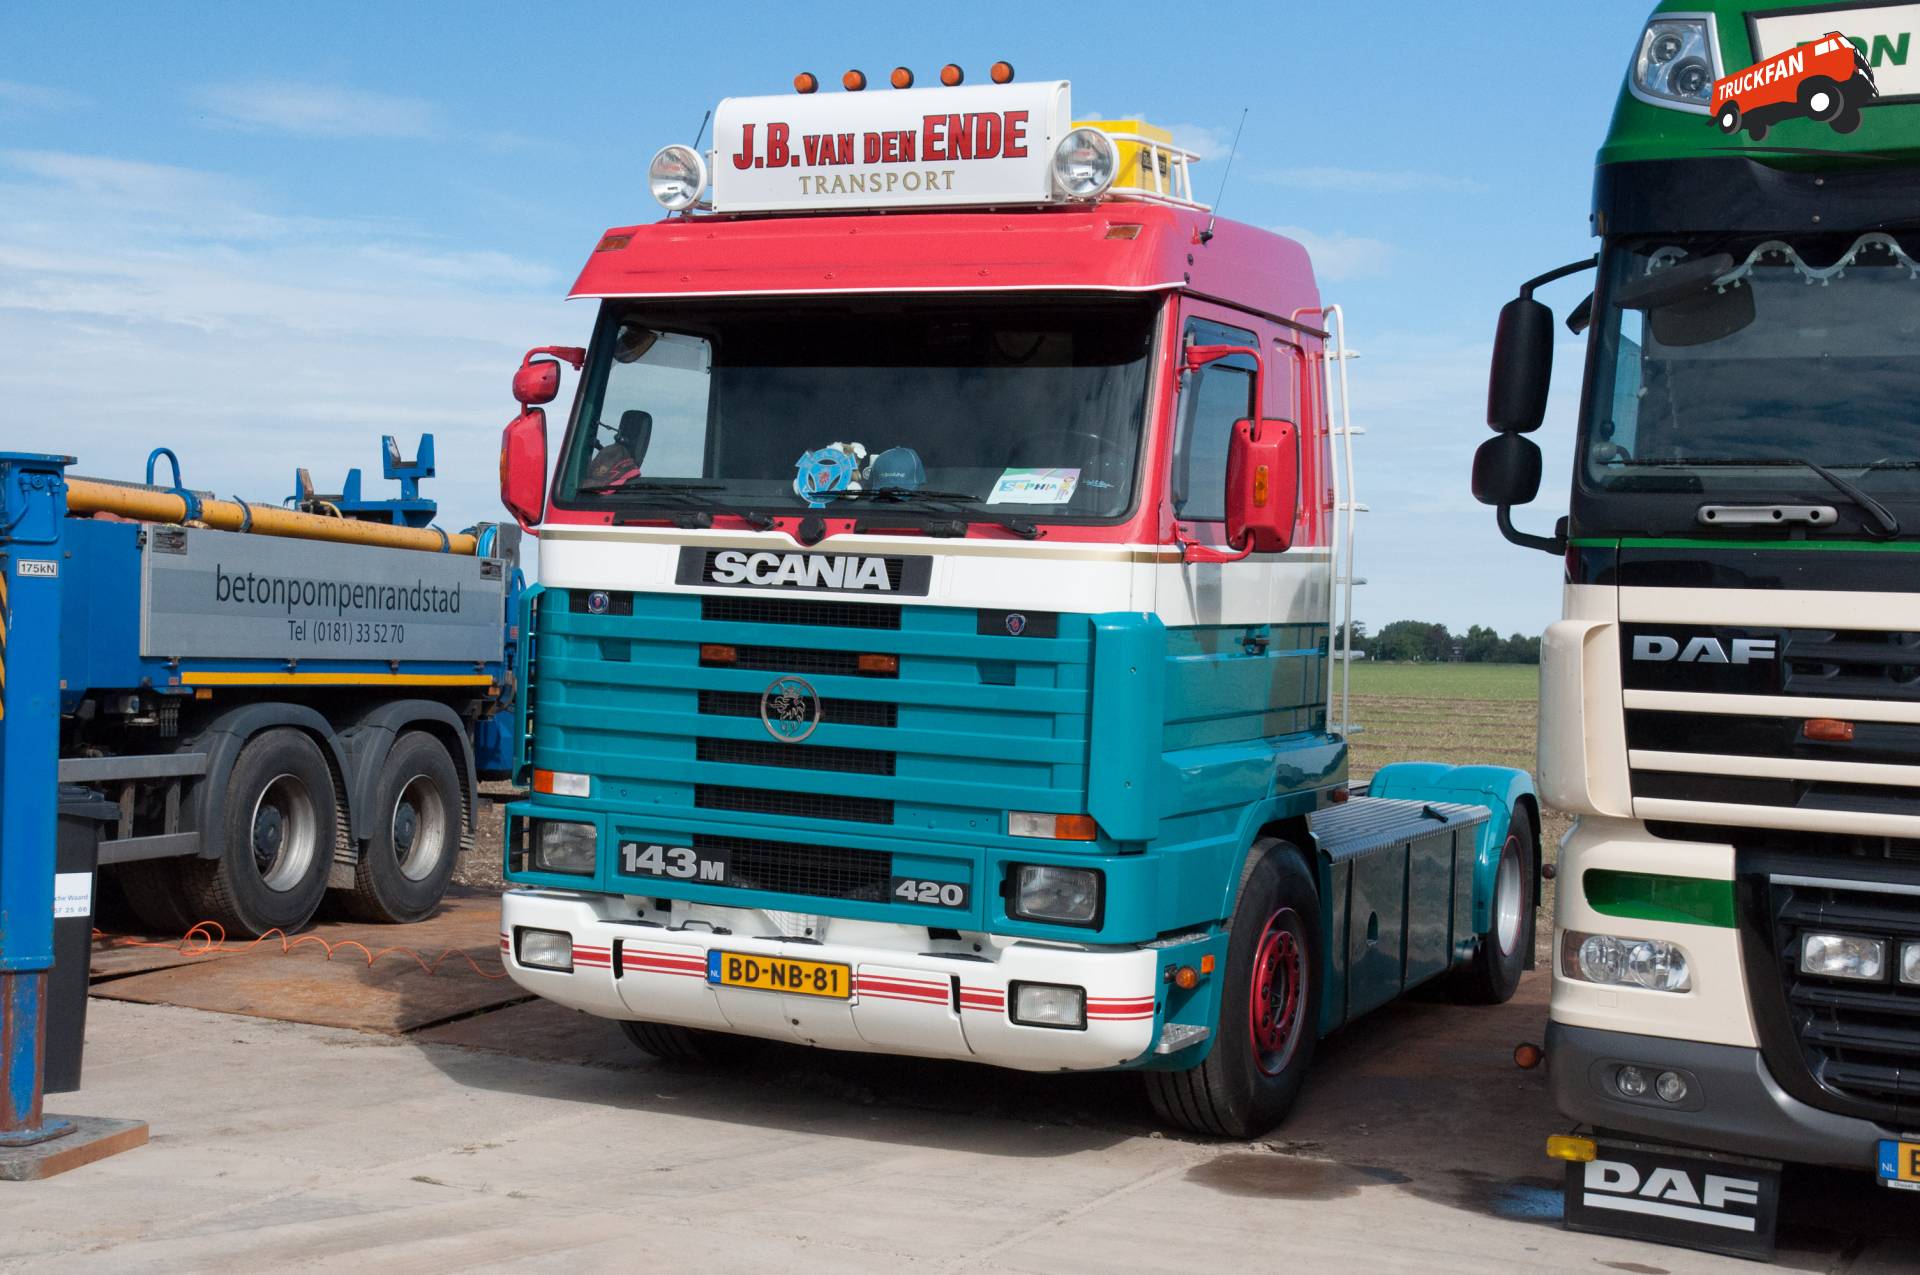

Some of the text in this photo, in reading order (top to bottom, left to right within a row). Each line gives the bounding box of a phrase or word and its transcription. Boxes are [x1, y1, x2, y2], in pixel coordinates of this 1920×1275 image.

[732, 110, 1029, 170] J.B. VAN DEN ENDE
[798, 170, 955, 196] TRANSPORT
[21, 563, 55, 574] 175kN
[711, 551, 892, 591] SCANIA
[216, 563, 461, 617] betonpompenrandstad
[288, 620, 306, 641] Tel
[313, 621, 353, 645] (0181)
[1632, 635, 1776, 664] DAF
[895, 880, 963, 906] 420
[710, 957, 838, 993] NL BD-NB-81
[1881, 1161, 1896, 1173] NL
[1584, 1159, 1759, 1208] DAF
